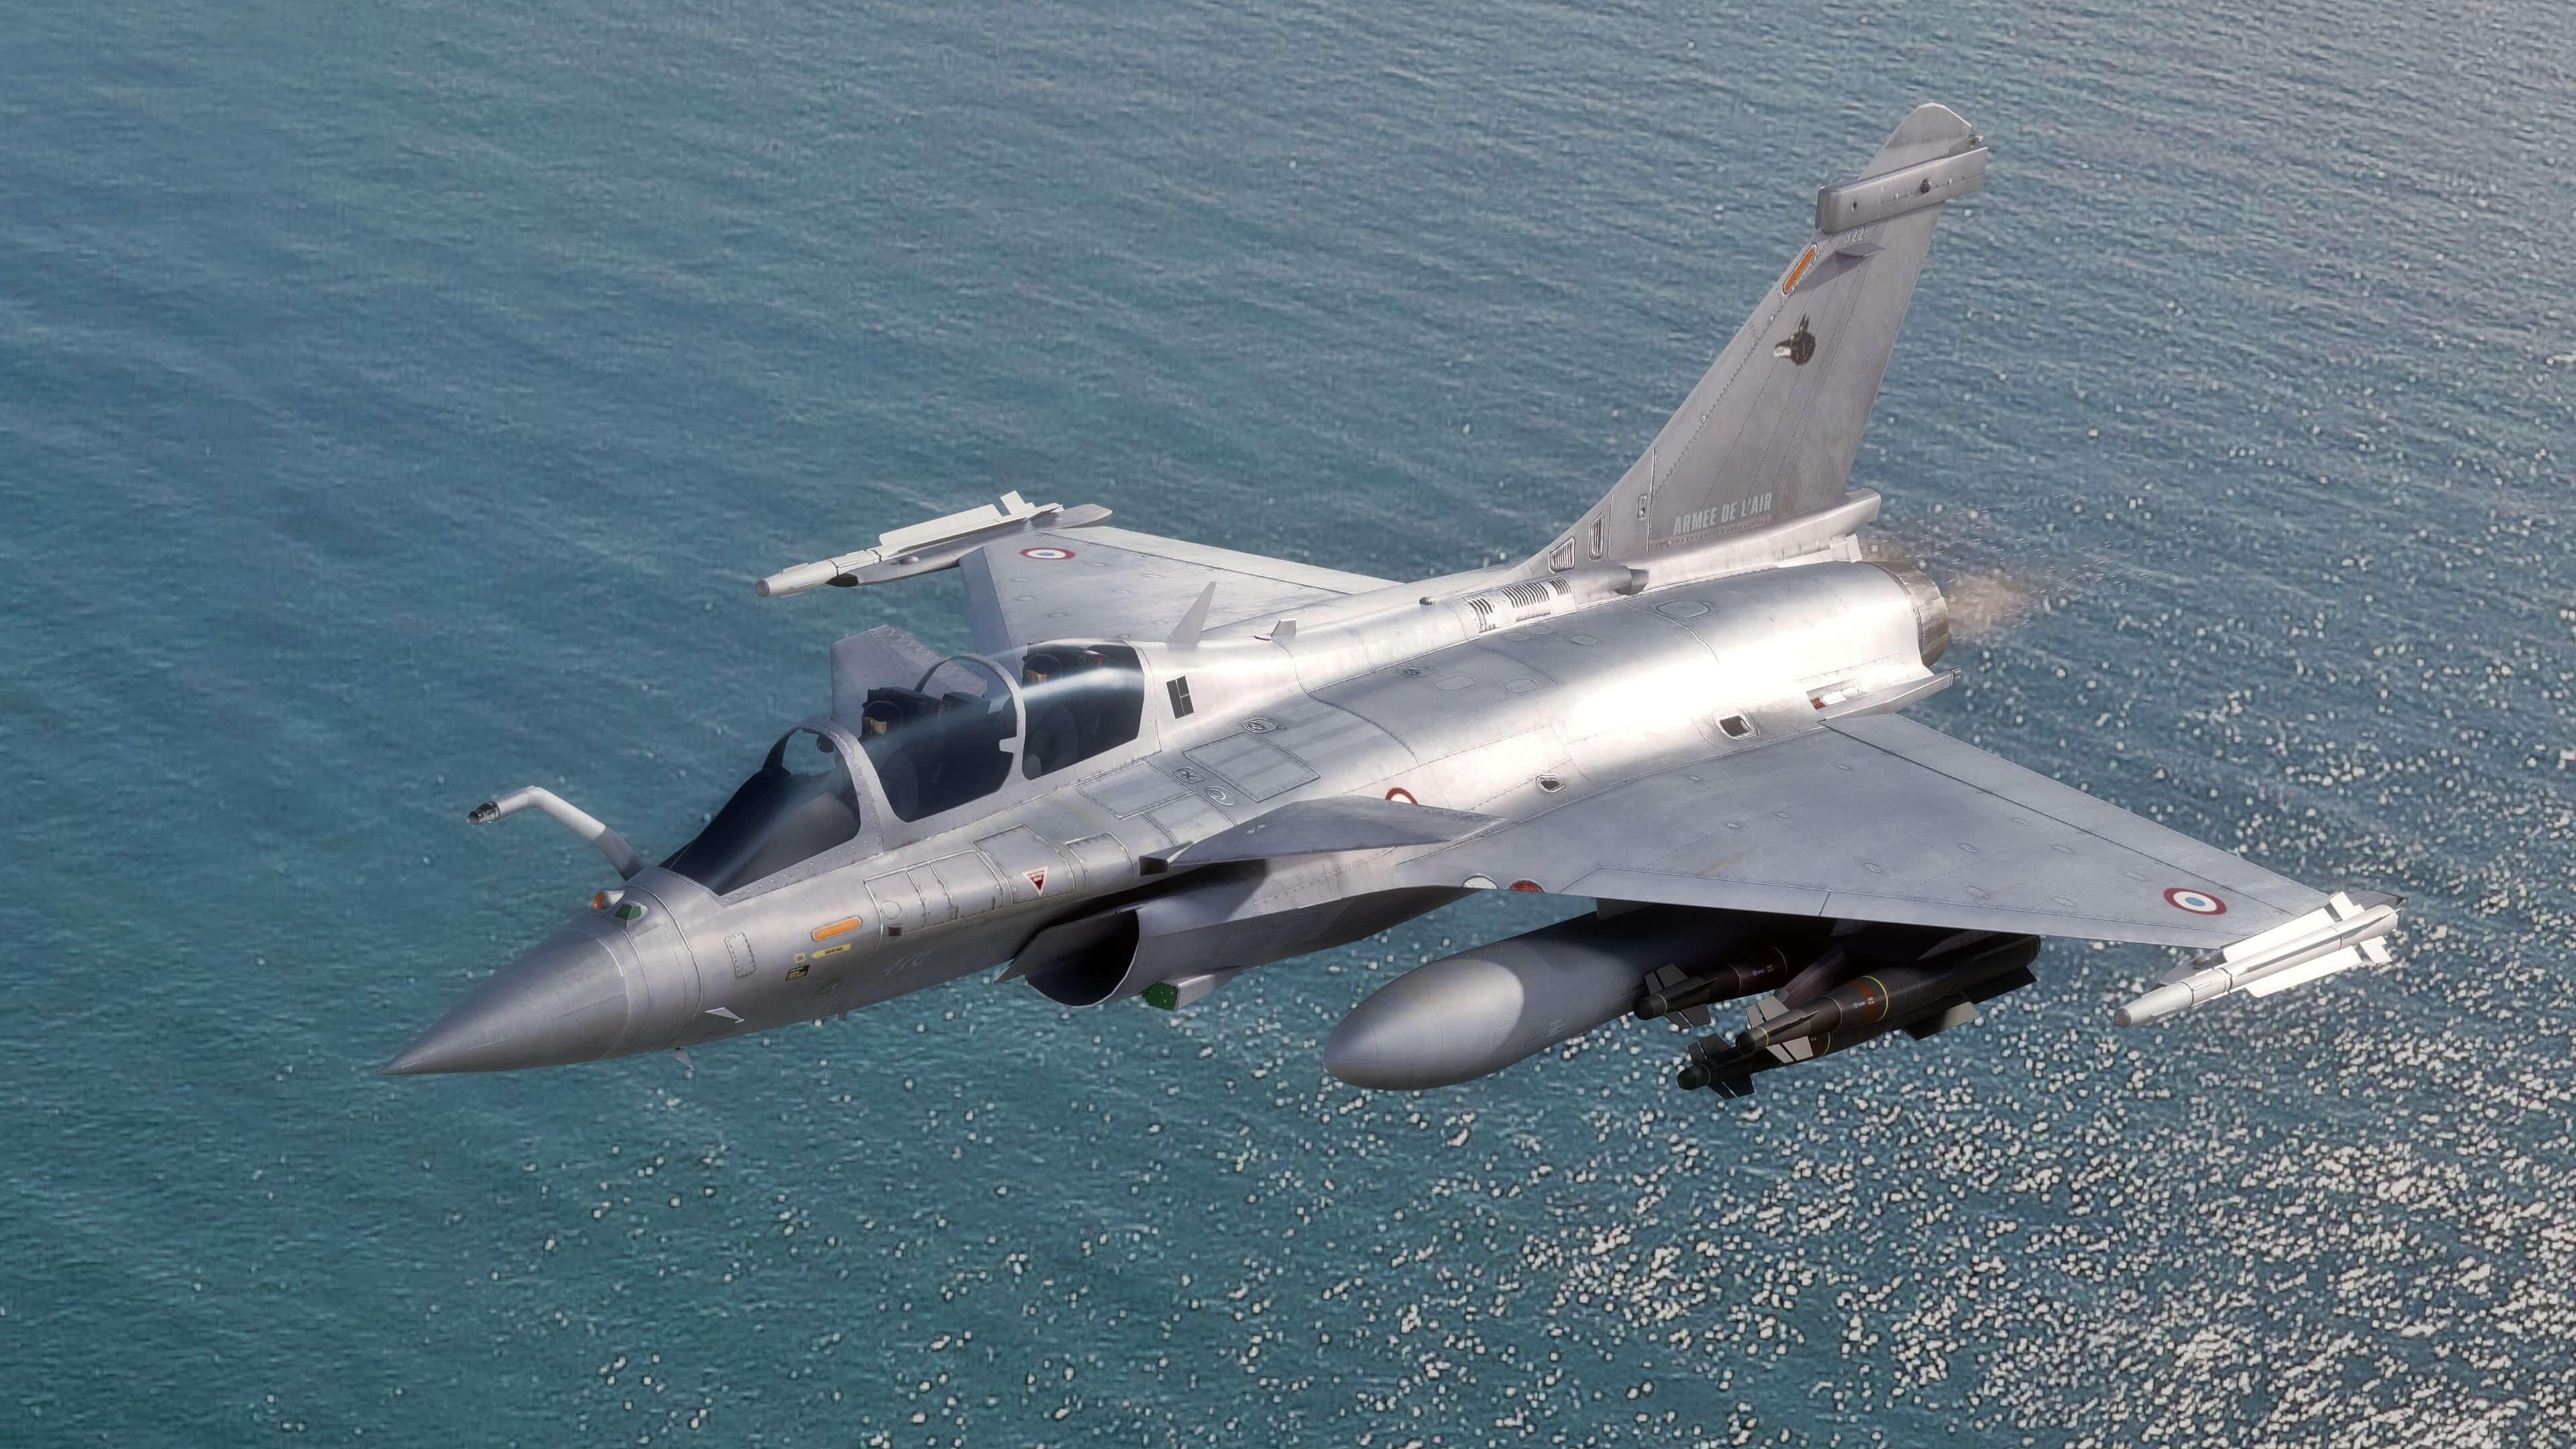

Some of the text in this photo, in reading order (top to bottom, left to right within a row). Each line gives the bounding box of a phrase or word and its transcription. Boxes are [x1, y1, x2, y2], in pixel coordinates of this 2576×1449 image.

[1673, 492, 1772, 535] ARMEE DE L'AIR
